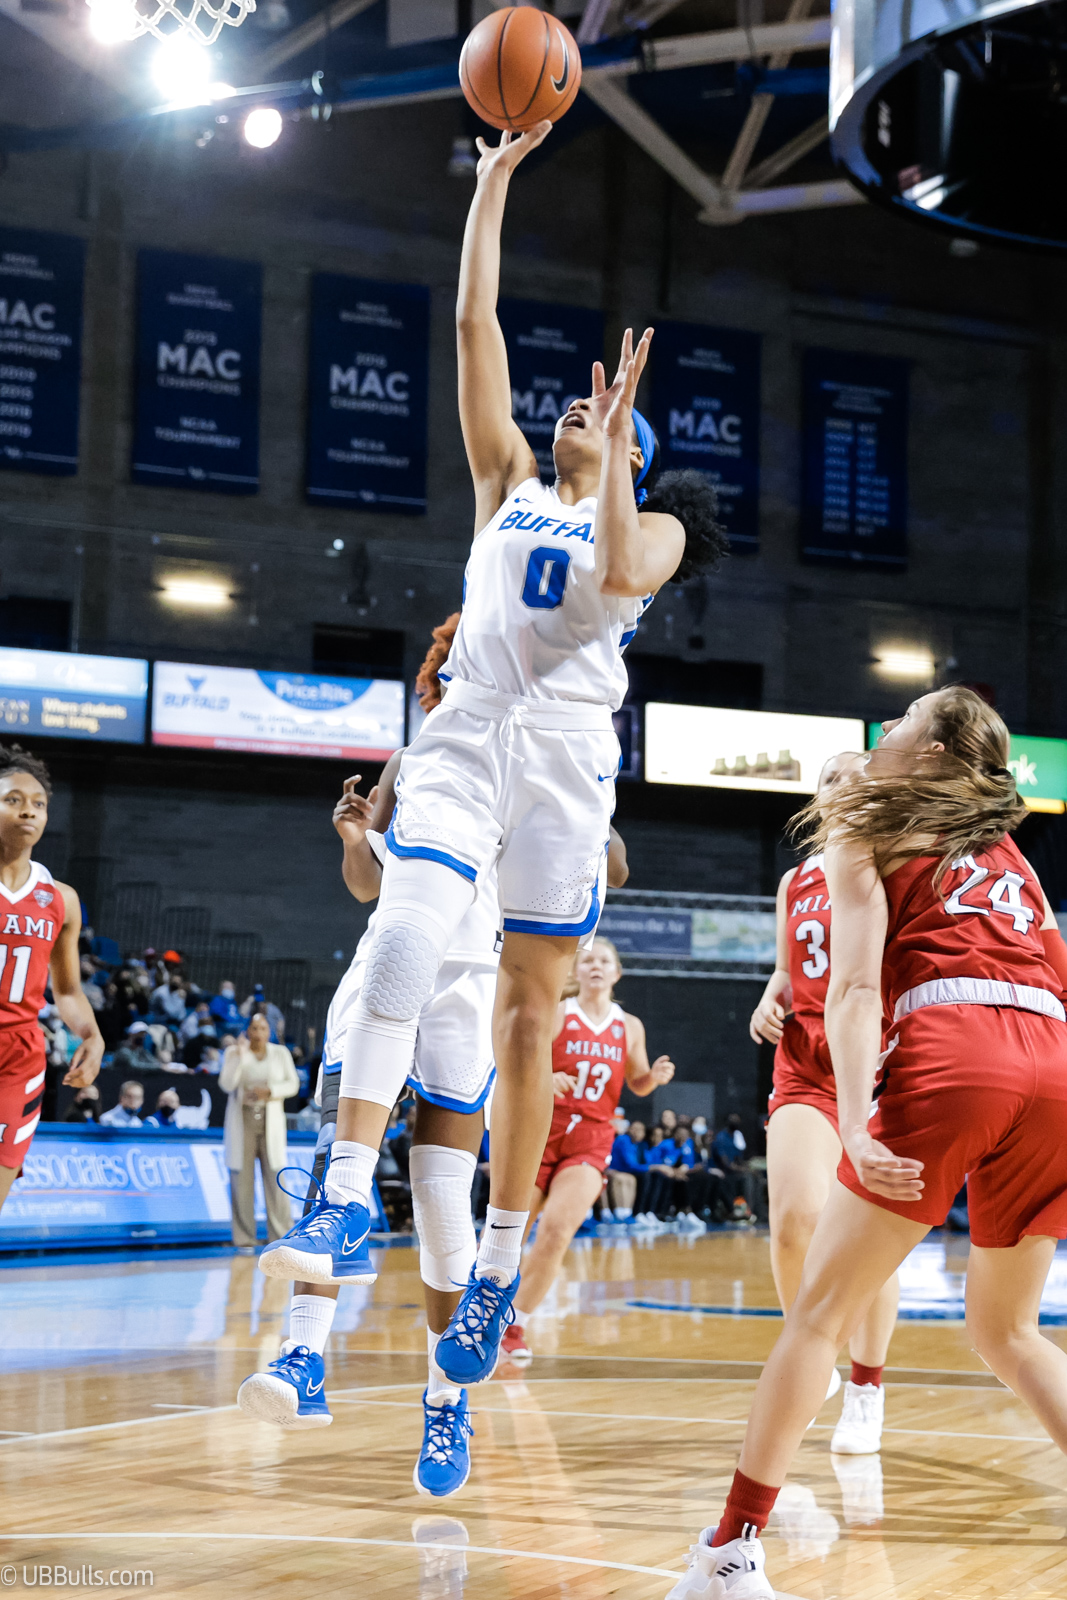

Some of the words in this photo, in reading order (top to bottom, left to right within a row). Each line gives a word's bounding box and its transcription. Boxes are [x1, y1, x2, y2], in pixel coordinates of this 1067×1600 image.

[157, 341, 241, 380] MAC
[329, 364, 410, 401] MAC
[668, 408, 742, 443] MAC
[497, 510, 594, 544] BUFFA
[519, 544, 573, 611] 0
[162, 692, 230, 711] BUFFALO
[1006, 754, 1038, 786] nk
[943, 854, 1034, 935] 24
[0, 913, 54, 941] AMI
[795, 919, 830, 979] 3
[565, 1040, 622, 1063] MIAMI
[572, 1060, 612, 1102] 13
[20, 1147, 129, 1190] ssociates
